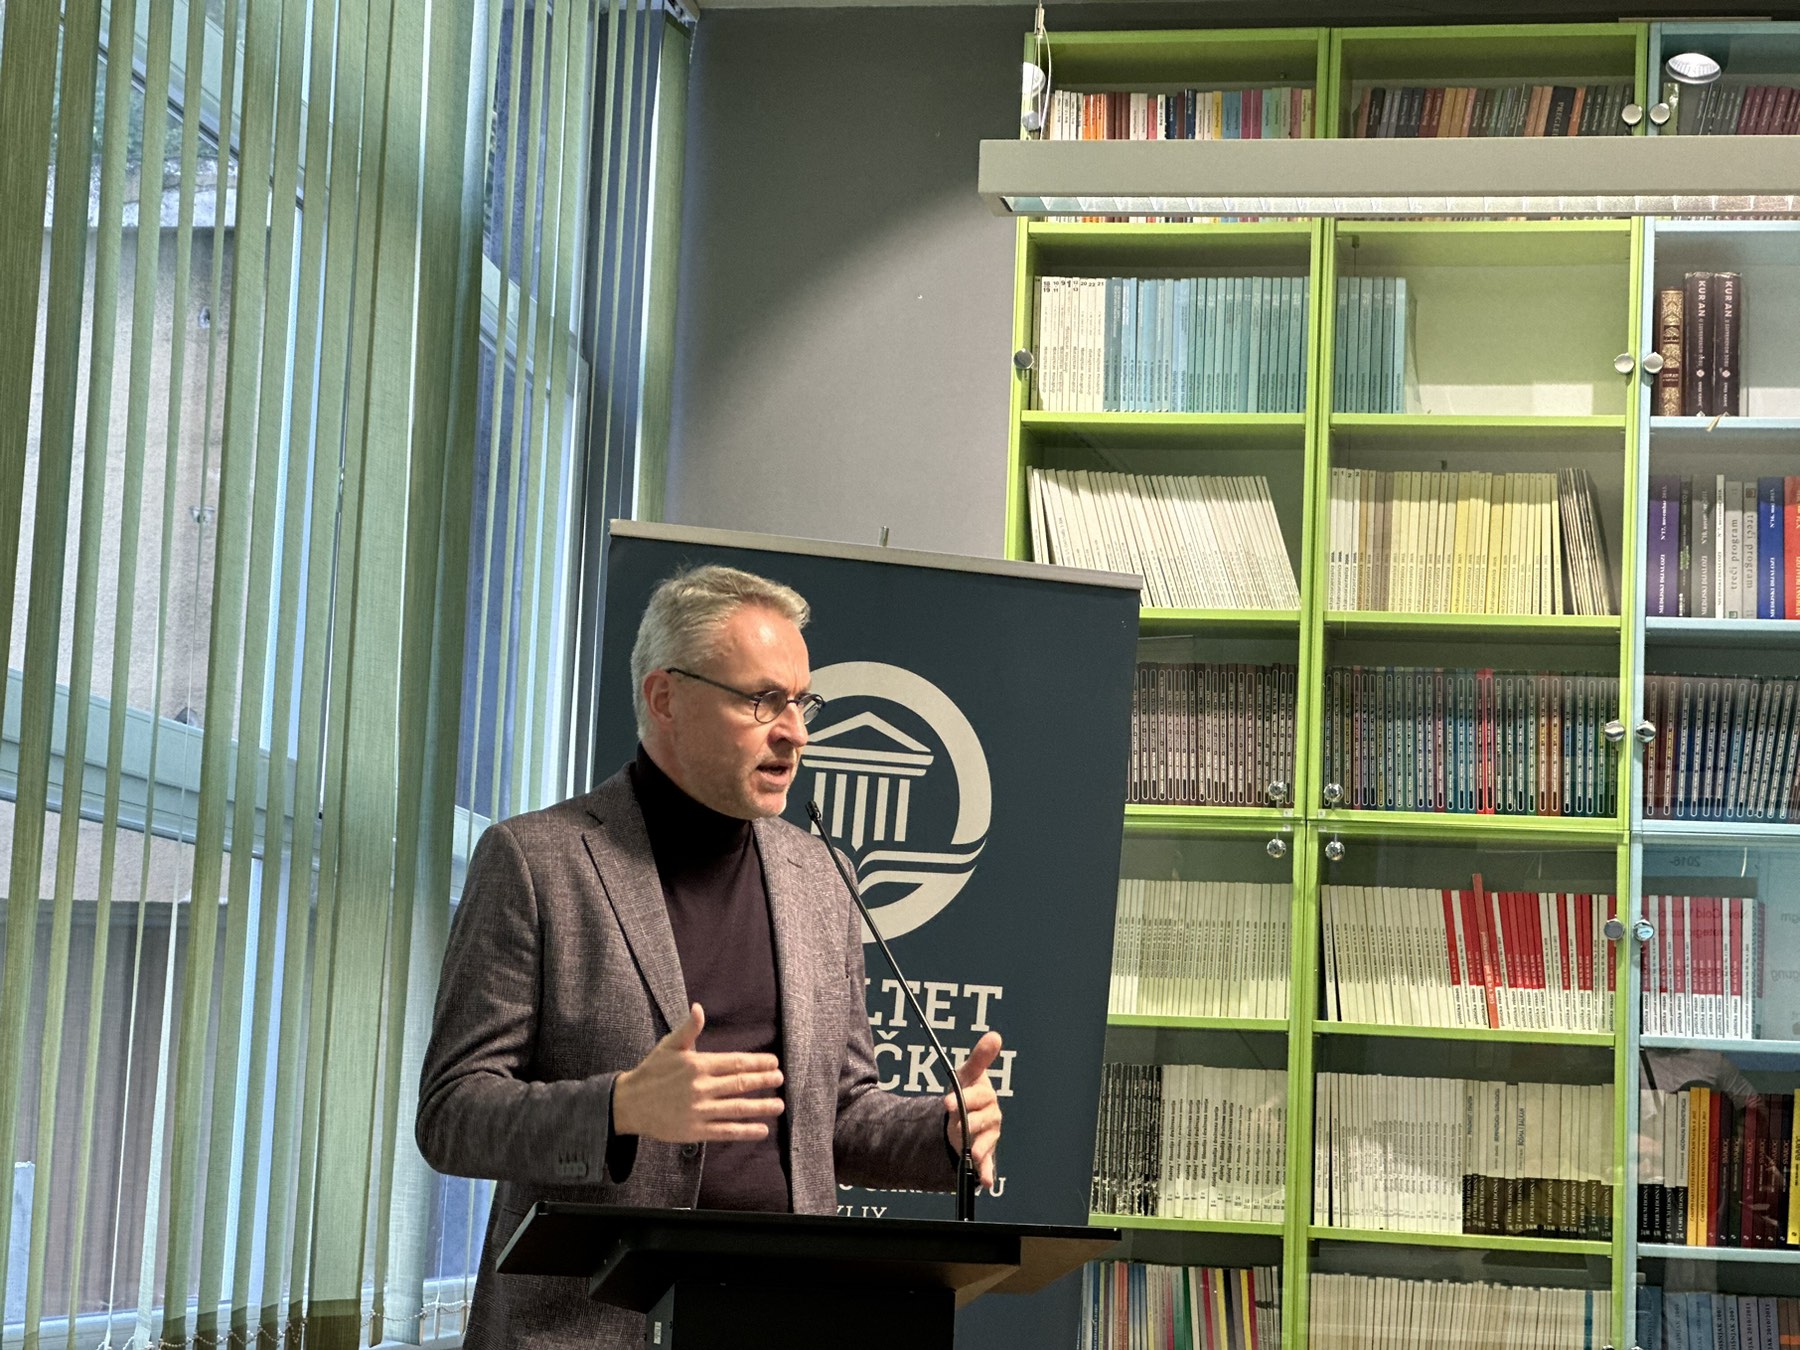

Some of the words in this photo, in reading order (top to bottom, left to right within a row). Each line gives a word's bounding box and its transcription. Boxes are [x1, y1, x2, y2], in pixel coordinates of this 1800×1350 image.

[1551, 102, 1564, 136] PREGLE
[1698, 280, 1706, 317] KUR'AN
[1725, 281, 1733, 317] KUR'AN
[1730, 519, 1740, 561] program
[1729, 567, 1738, 589] treći
[1745, 544, 1754, 588] program
